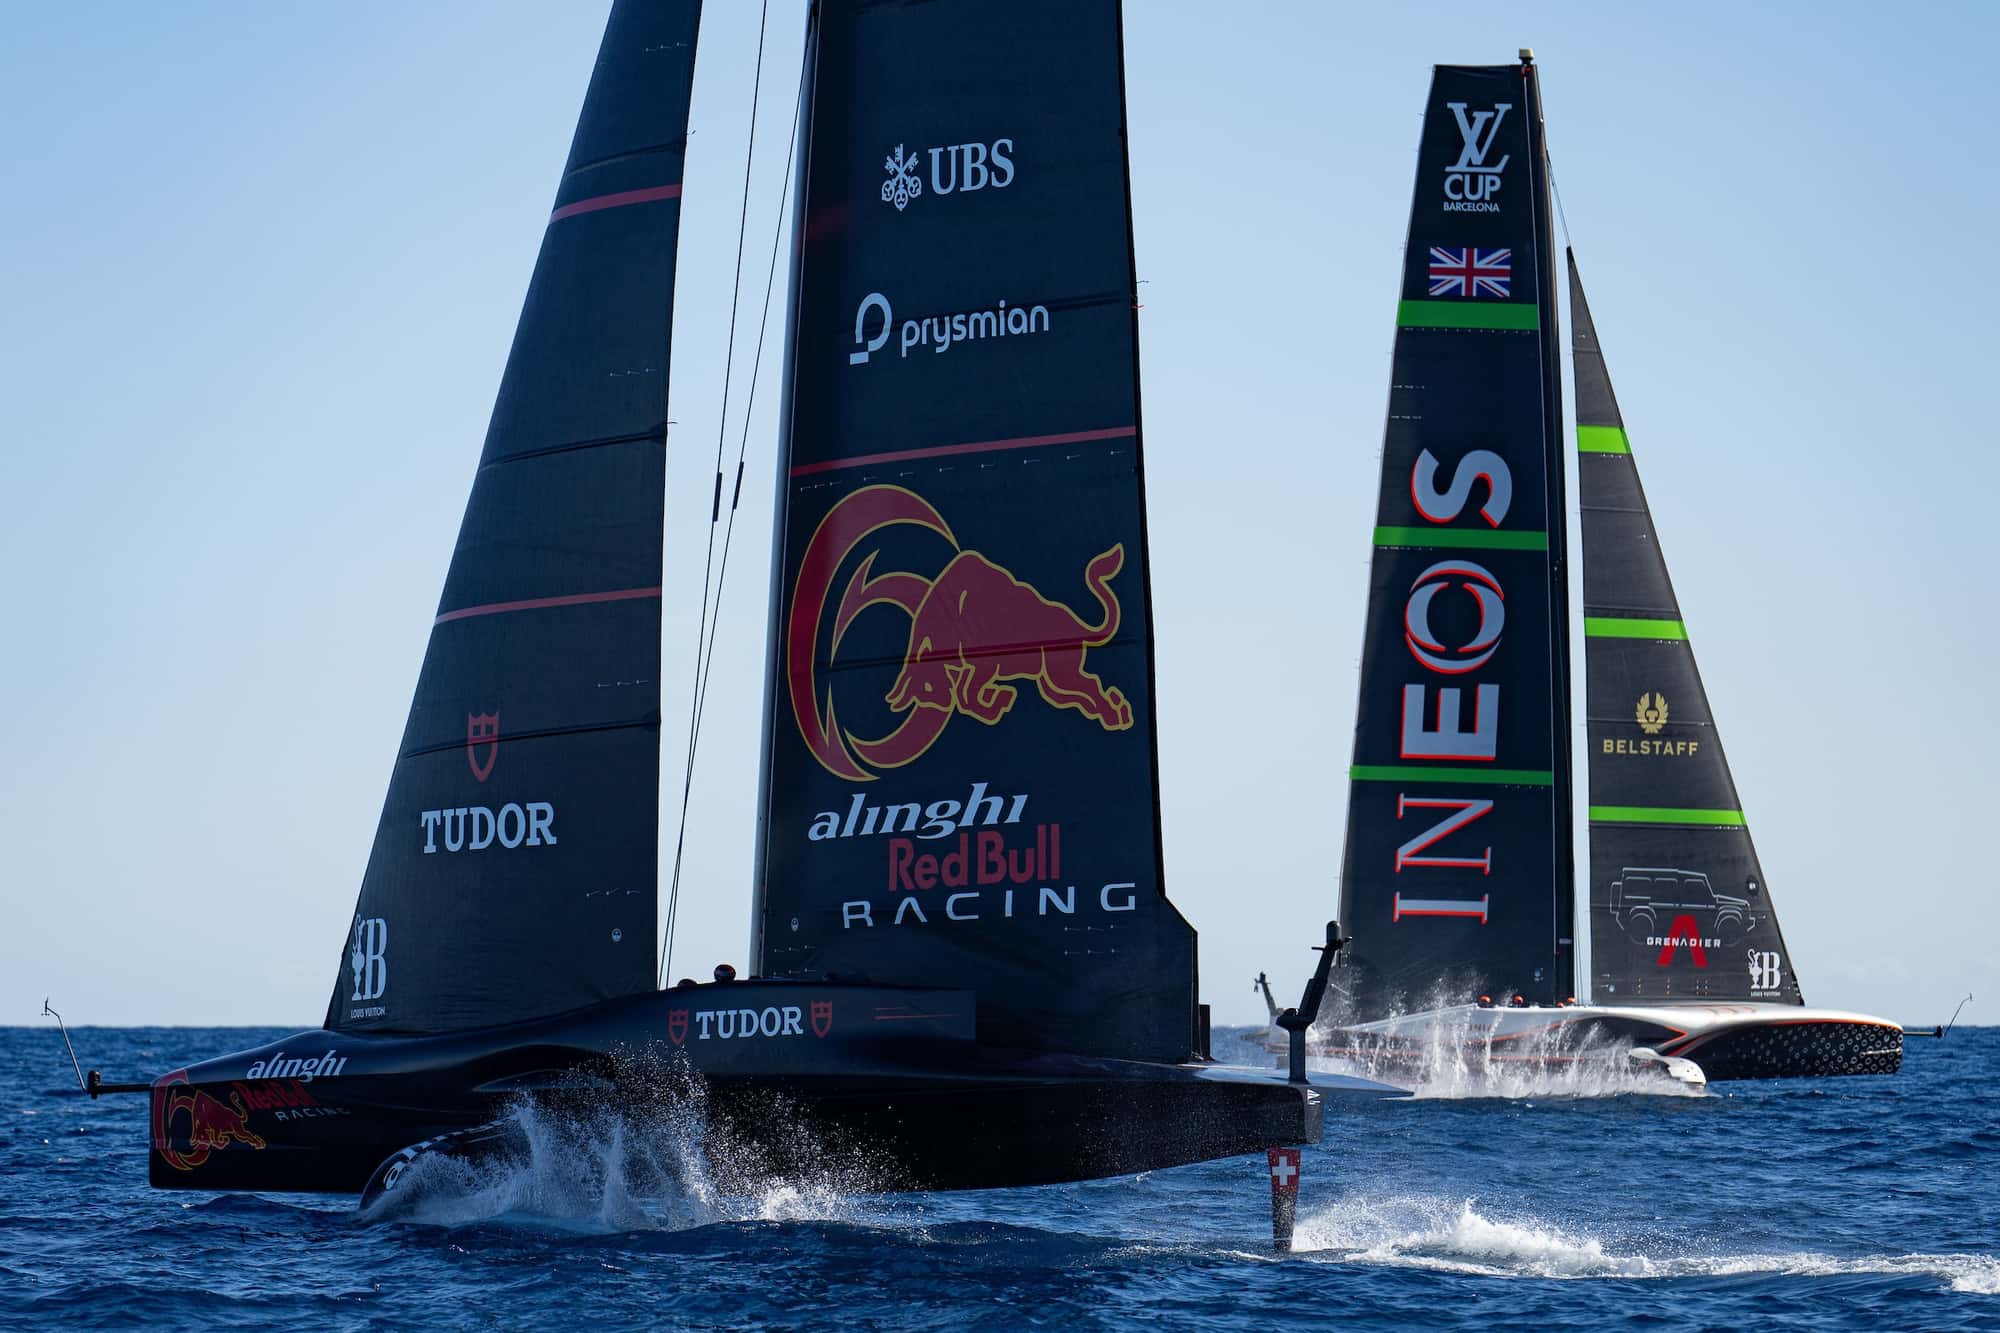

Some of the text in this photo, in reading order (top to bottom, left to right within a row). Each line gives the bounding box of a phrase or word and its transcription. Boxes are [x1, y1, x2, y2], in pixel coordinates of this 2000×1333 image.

[928, 138, 1015, 195] UBS
[1444, 174, 1502, 201] CUP
[1443, 201, 1501, 213] BARCELONA
[901, 299, 1050, 358] prysmian
[1393, 447, 1514, 925] INEOS
[1602, 738, 1700, 757] BELSTAFF
[421, 801, 557, 854] TUDOR
[807, 782, 1029, 841] alinghi
[888, 823, 1060, 892] Red Bull
[842, 882, 1136, 929] RACING
[1645, 936, 1722, 949] GRENADIER
[695, 1006, 804, 1040] TUDOR
[246, 1049, 348, 1083] alinghi
